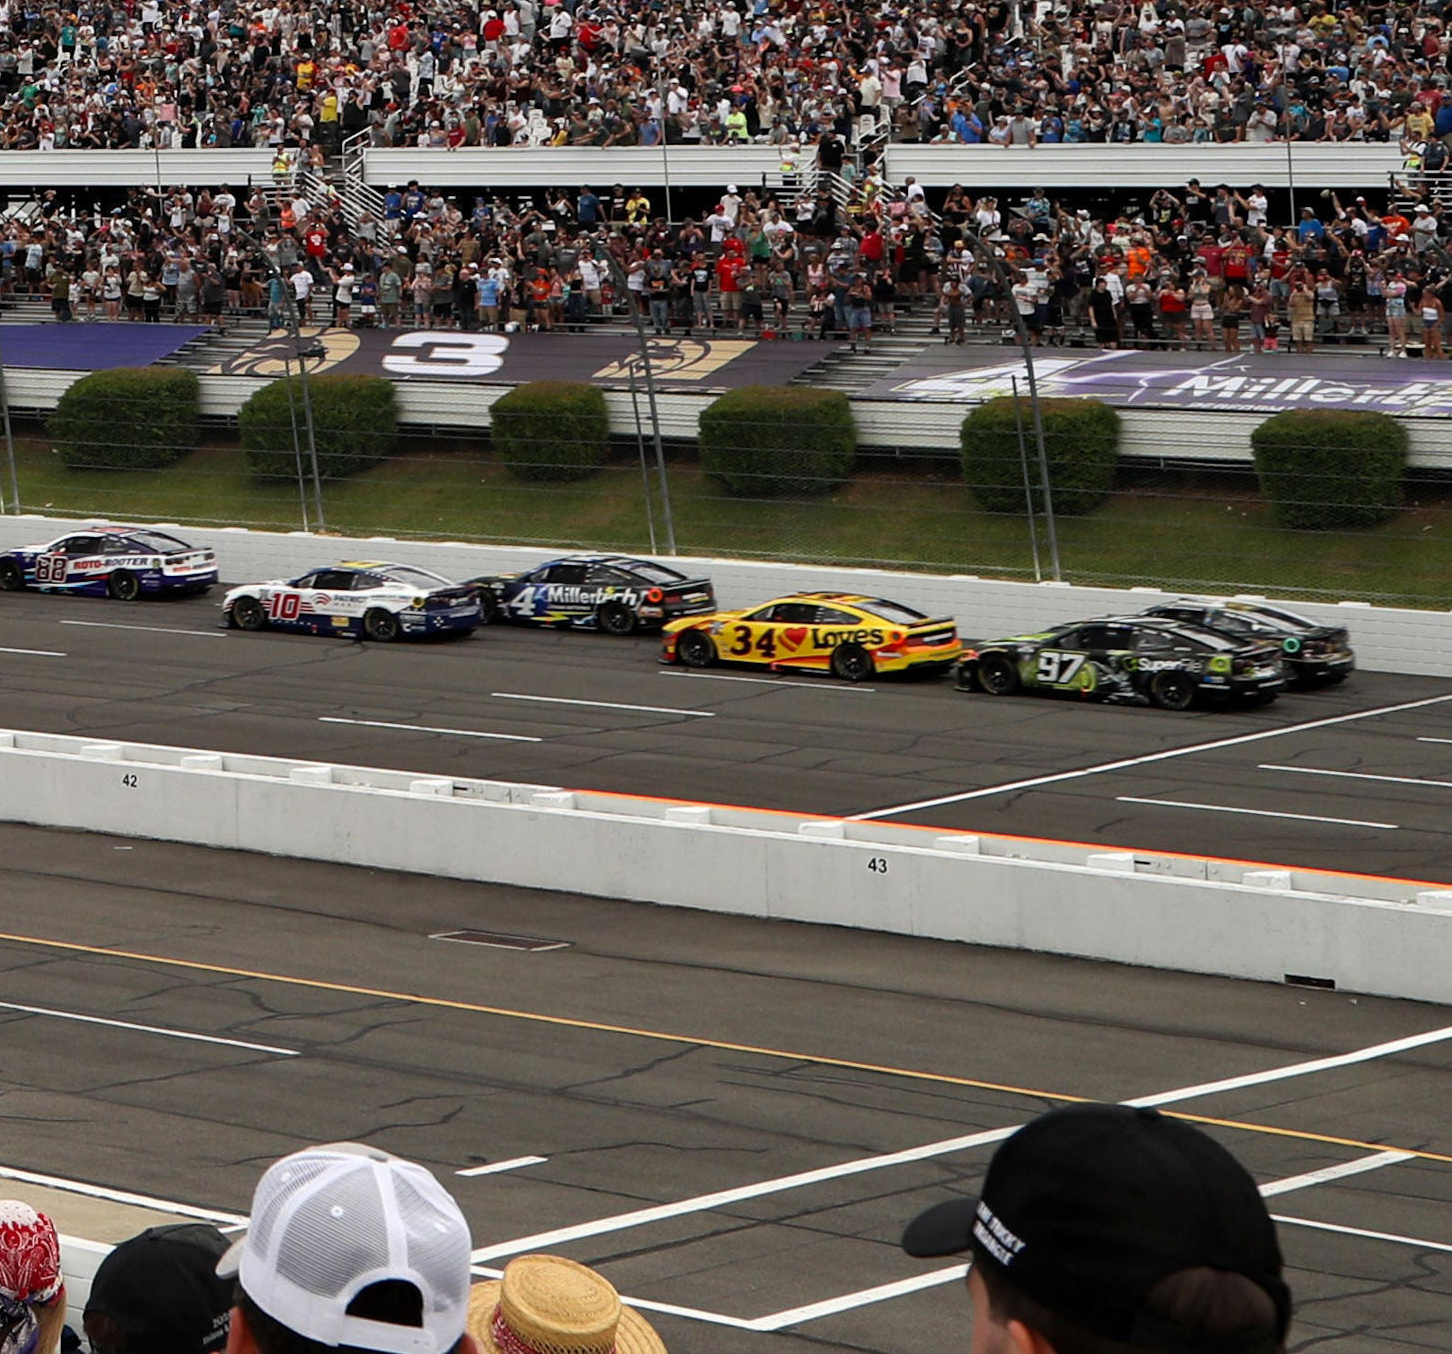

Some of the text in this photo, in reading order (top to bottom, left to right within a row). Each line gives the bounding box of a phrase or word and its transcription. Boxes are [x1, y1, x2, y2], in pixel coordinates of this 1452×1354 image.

[381, 331, 511, 376] 3
[35, 555, 69, 584] 88
[73, 557, 149, 570] ROTO-ROOTER
[269, 592, 301, 621] 10
[510, 586, 537, 616] 4
[731, 625, 777, 658] 34
[1037, 651, 1086, 684] 97
[122, 773, 138, 788] 42
[867, 857, 888, 874] 43
[988, 1216, 1027, 1254] TRICKY
